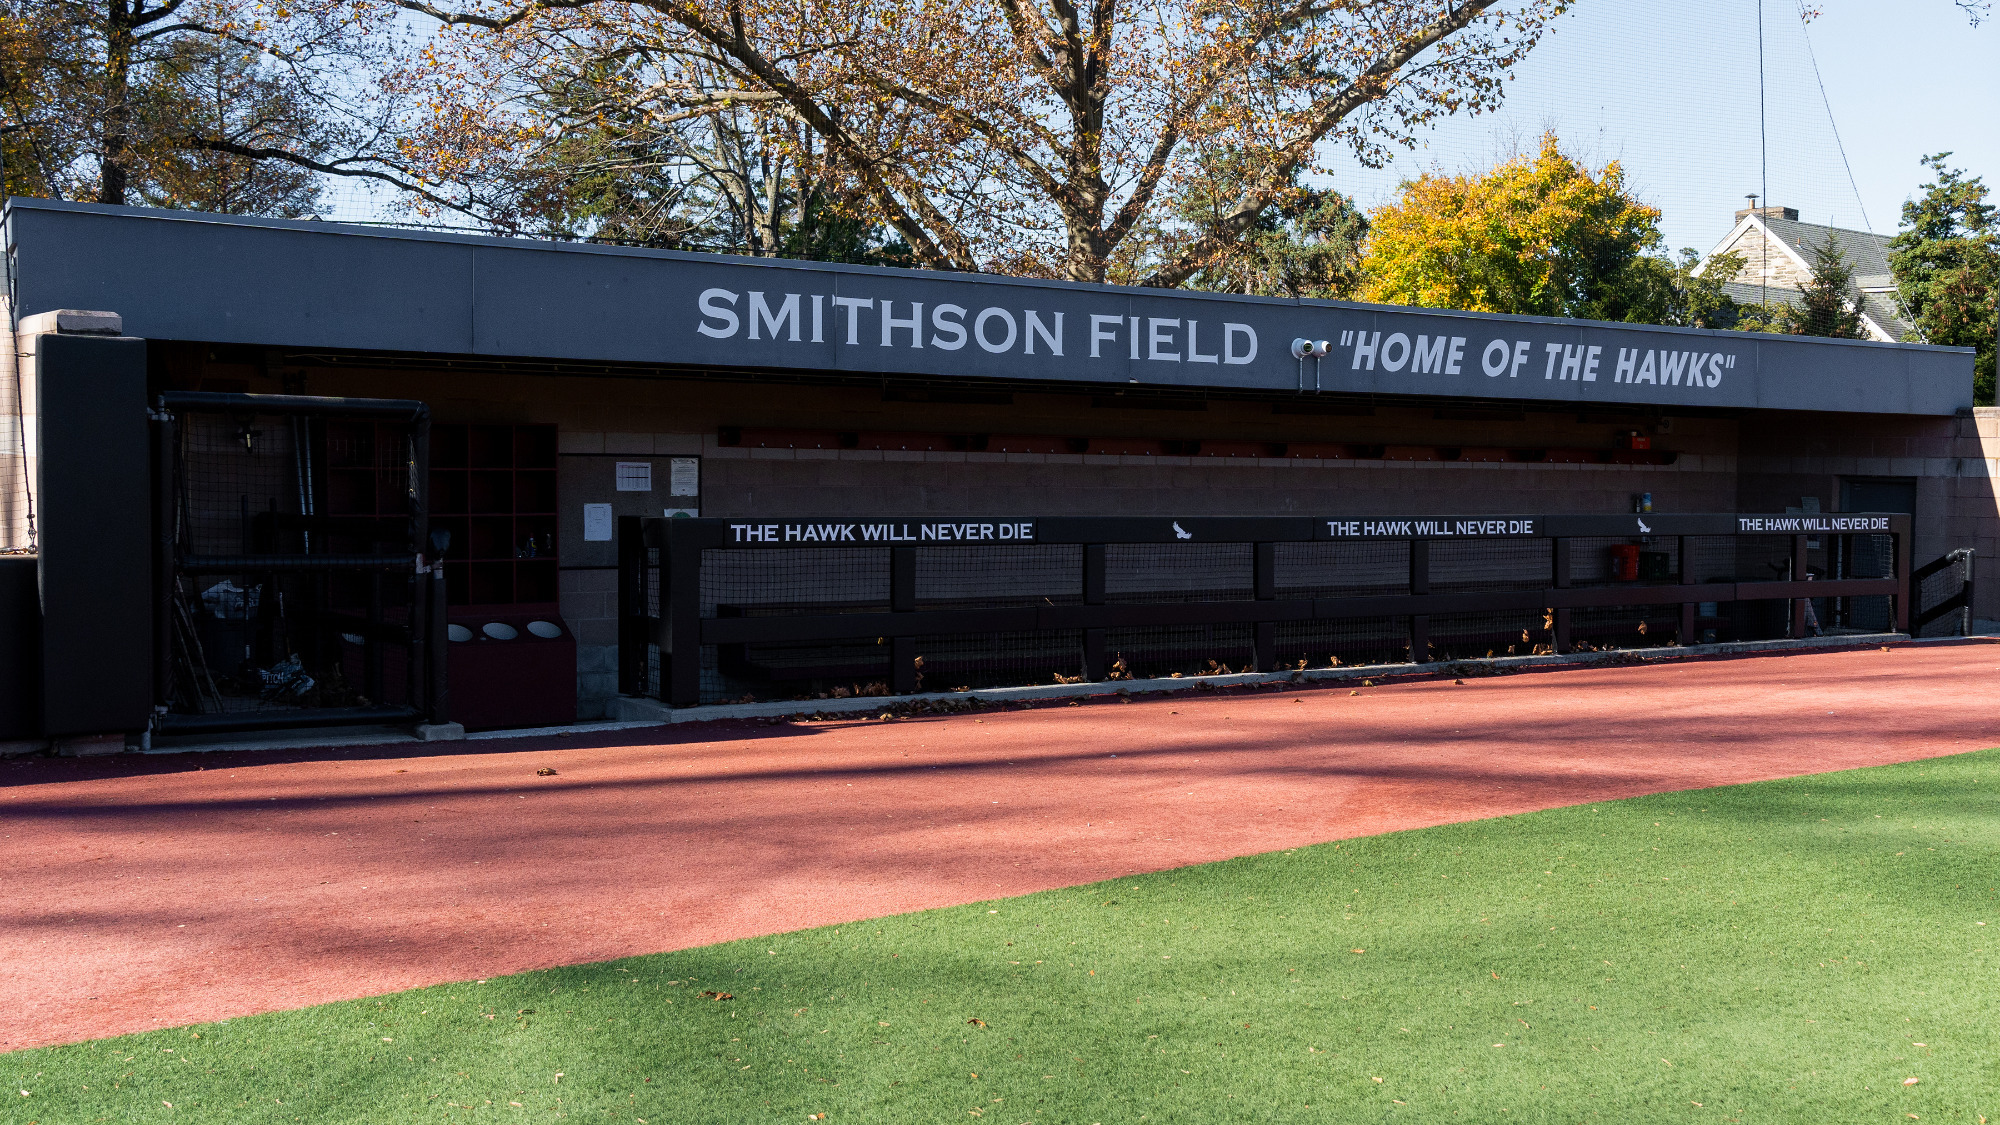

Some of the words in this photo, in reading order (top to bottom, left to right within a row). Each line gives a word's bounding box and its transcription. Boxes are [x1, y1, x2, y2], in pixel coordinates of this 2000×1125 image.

[696, 287, 1065, 356] SMITHSON
[1089, 314, 1259, 366] FIELD
[1339, 330, 1467, 374] "HOME
[1481, 338, 1531, 378] OF
[1544, 342, 1603, 382] THE
[1613, 347, 1736, 388] HAWKS"
[730, 524, 779, 542] THE
[785, 524, 856, 542] HAWK
[860, 524, 917, 541] WILL
[921, 523, 995, 541] NEVER
[998, 522, 1033, 540] DIE
[1326, 521, 1361, 536] THE
[1363, 521, 1412, 536] HAWK
[1414, 521, 1454, 536] WILL
[1455, 520, 1507, 535] NEVER
[1509, 520, 1534, 534] DIE
[1738, 518, 1764, 531] THE
[1765, 518, 1801, 531] HAWK
[1801, 518, 1831, 531] WILL
[1831, 517, 1869, 530] NEVER
[1870, 517, 1889, 530] DIE
